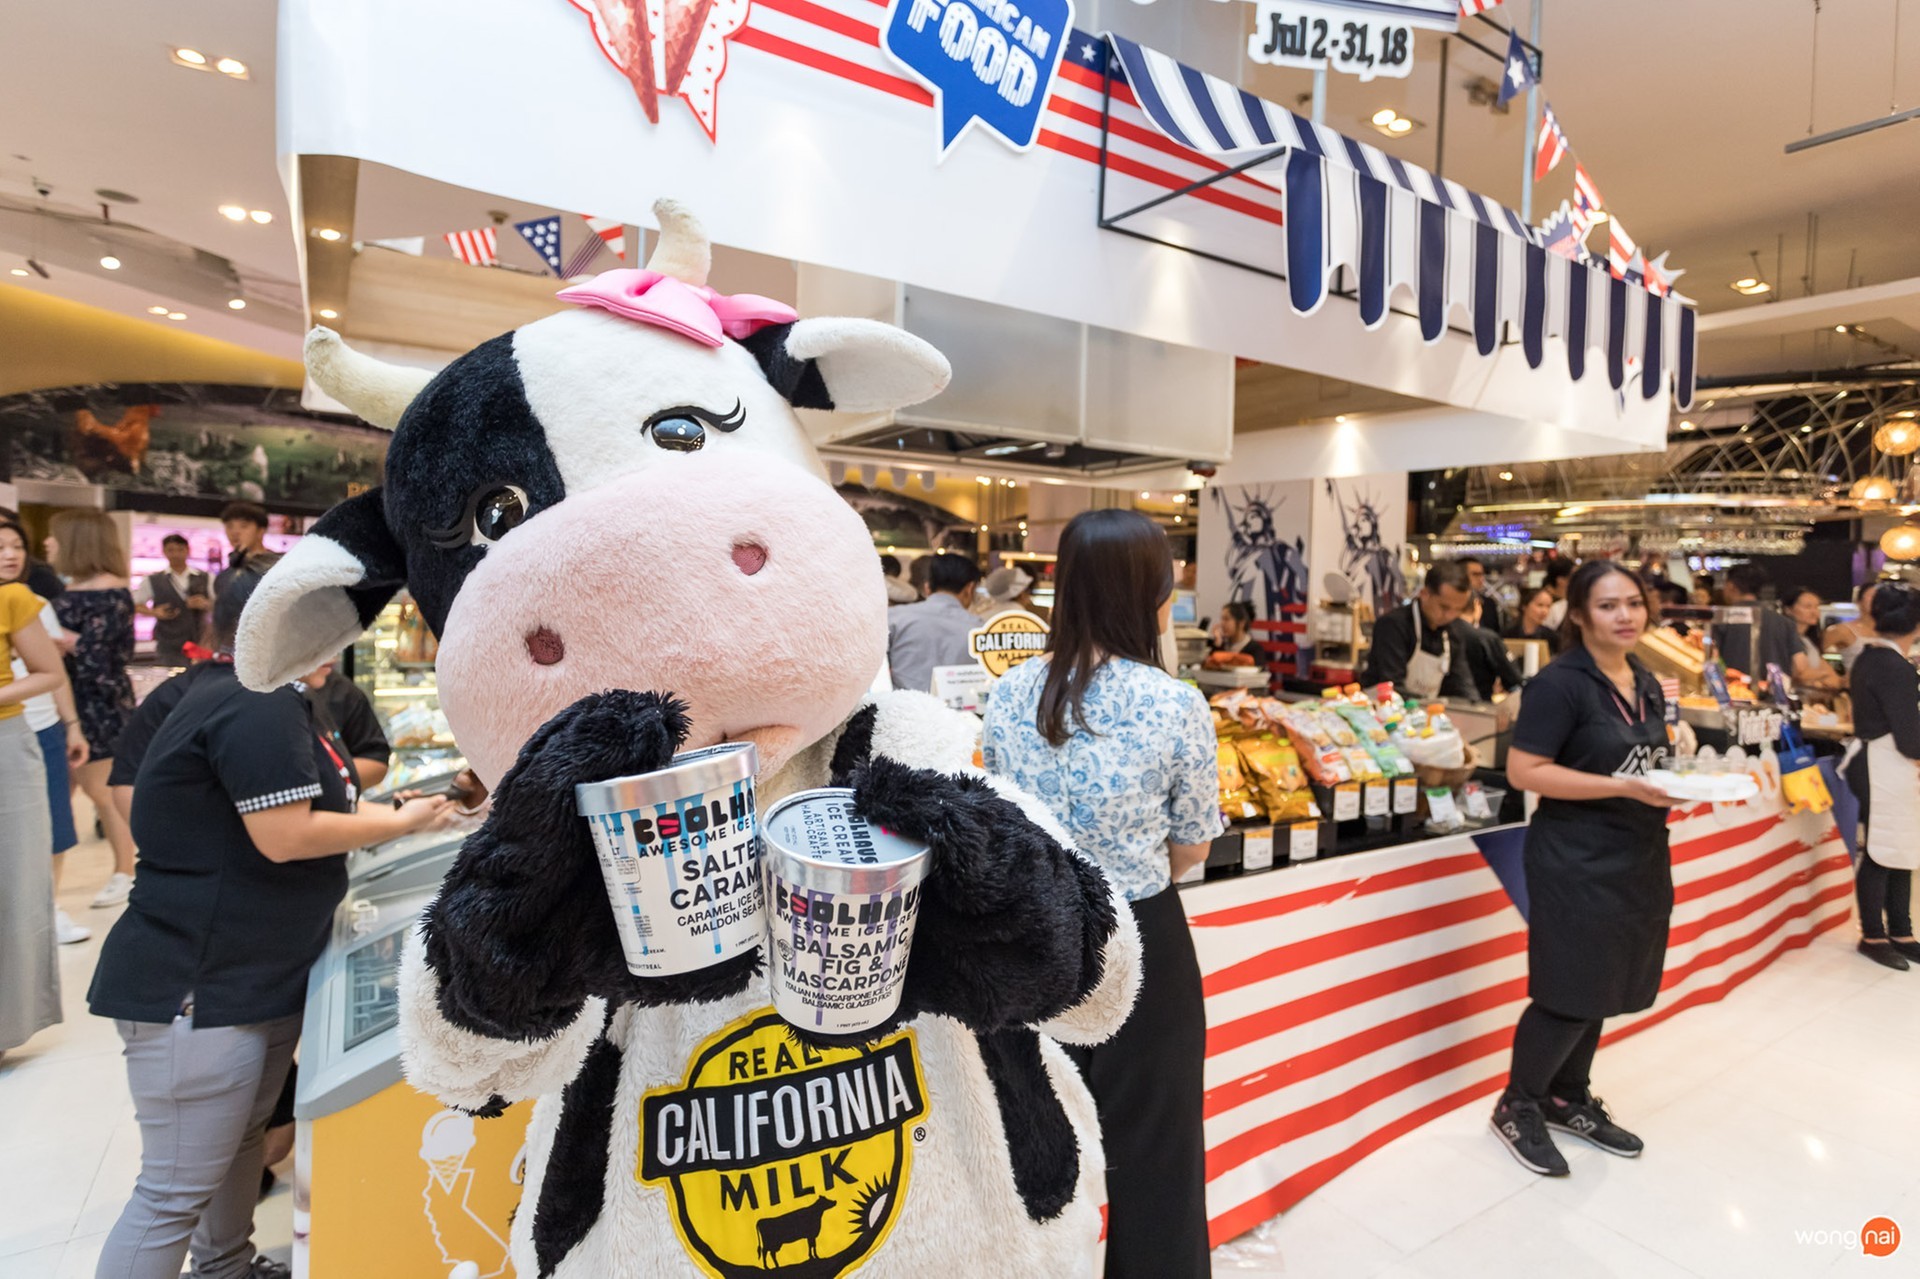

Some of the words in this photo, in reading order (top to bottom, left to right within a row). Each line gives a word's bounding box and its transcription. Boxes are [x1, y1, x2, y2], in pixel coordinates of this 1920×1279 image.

[906, 0, 1038, 107] FOOD
[1264, 12, 1307, 59] Jul
[1379, 26, 1409, 67] 18
[975, 633, 1047, 652] CALIFORNI
[633, 787, 755, 845] COOLHA
[825, 802, 843, 821] ICE
[639, 826, 727, 858] AWESOME
[733, 817, 750, 834] ICE
[801, 804, 823, 860] HAND-CRAFTE
[813, 813, 828, 848] ARTISAN
[832, 825, 857, 865] CREAM
[670, 861, 762, 910] CARAM
[677, 901, 734, 927] CARAMEL
[737, 892, 752, 908] ICE
[690, 911, 740, 937] MALDON
[742, 902, 757, 919] SEA
[777, 909, 850, 937] AWESOME
[857, 924, 884, 937] ICE
[890, 902, 920, 929] CREA
[793, 927, 909, 959] BALSAMIC
[783, 954, 908, 991] MASCARPONE
[821, 958, 861, 975] FIG
[869, 955, 883, 972] &
[785, 981, 812, 998] ITALIAN
[811, 990, 872, 1003] MASCARPONE
[872, 986, 884, 998] ICE
[801, 996, 845, 1010] BALSAMIC
[845, 997, 877, 1010] GLAZED
[877, 990, 893, 1003] FIGS
[729, 1041, 823, 1081] REAL
[656, 1054, 914, 1167] CALIFORNIA
[720, 1147, 859, 1212] MILK
